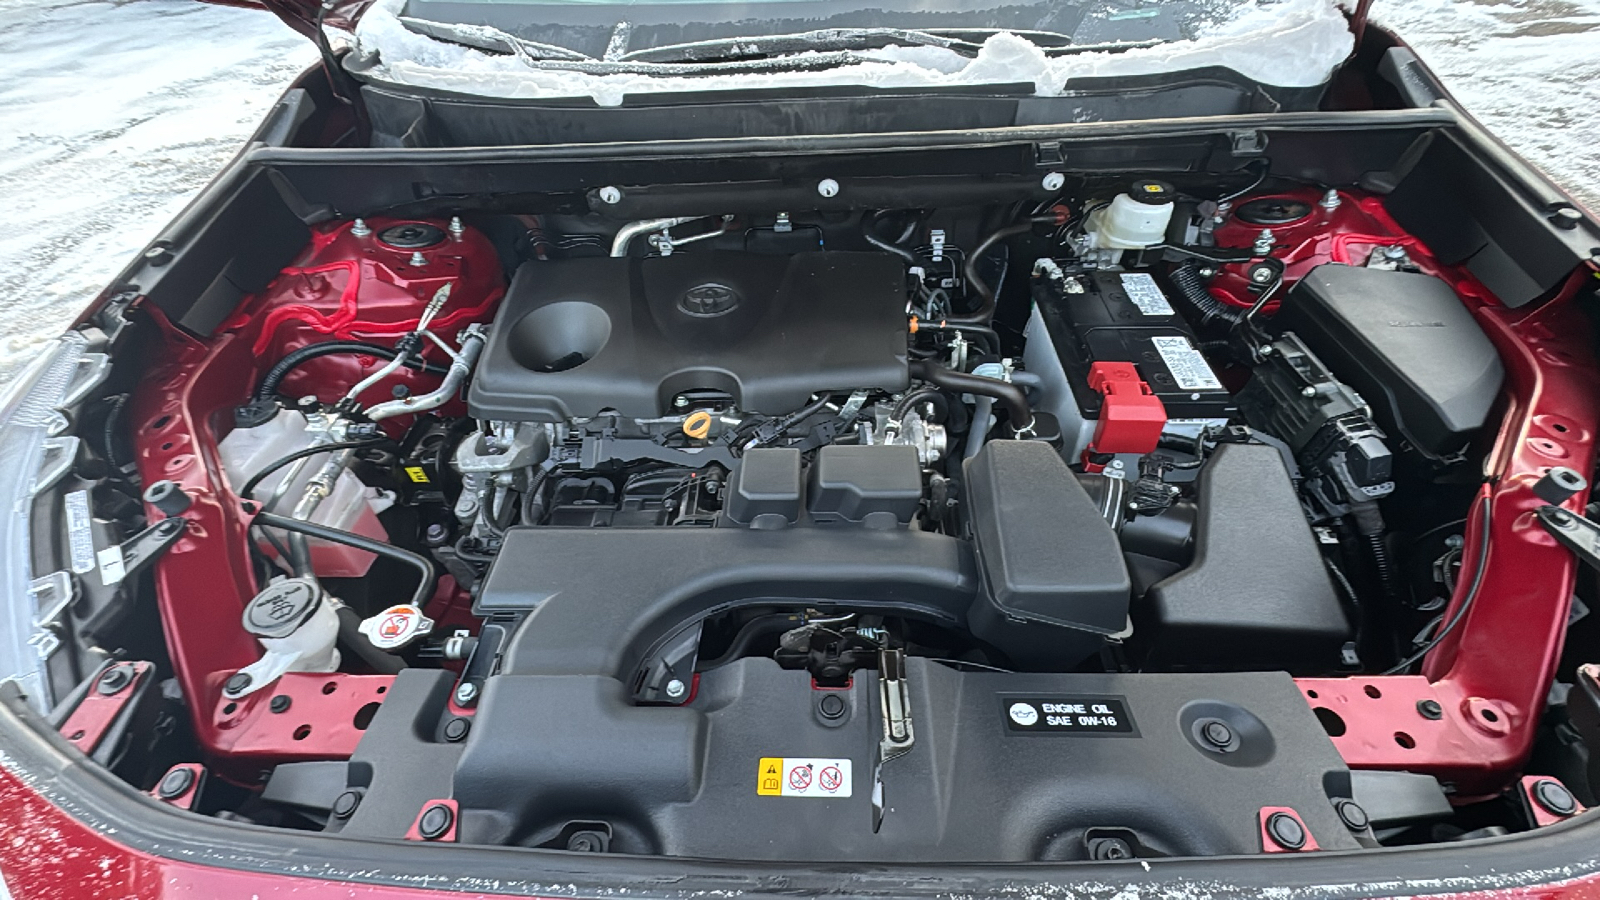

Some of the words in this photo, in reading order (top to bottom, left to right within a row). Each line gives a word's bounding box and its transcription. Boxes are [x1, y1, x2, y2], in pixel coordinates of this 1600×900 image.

[1042, 703, 1087, 714] ENGINE
[1091, 704, 1114, 714] OIL
[1046, 715, 1073, 726] SAE
[1078, 716, 1118, 727] 0W-16
